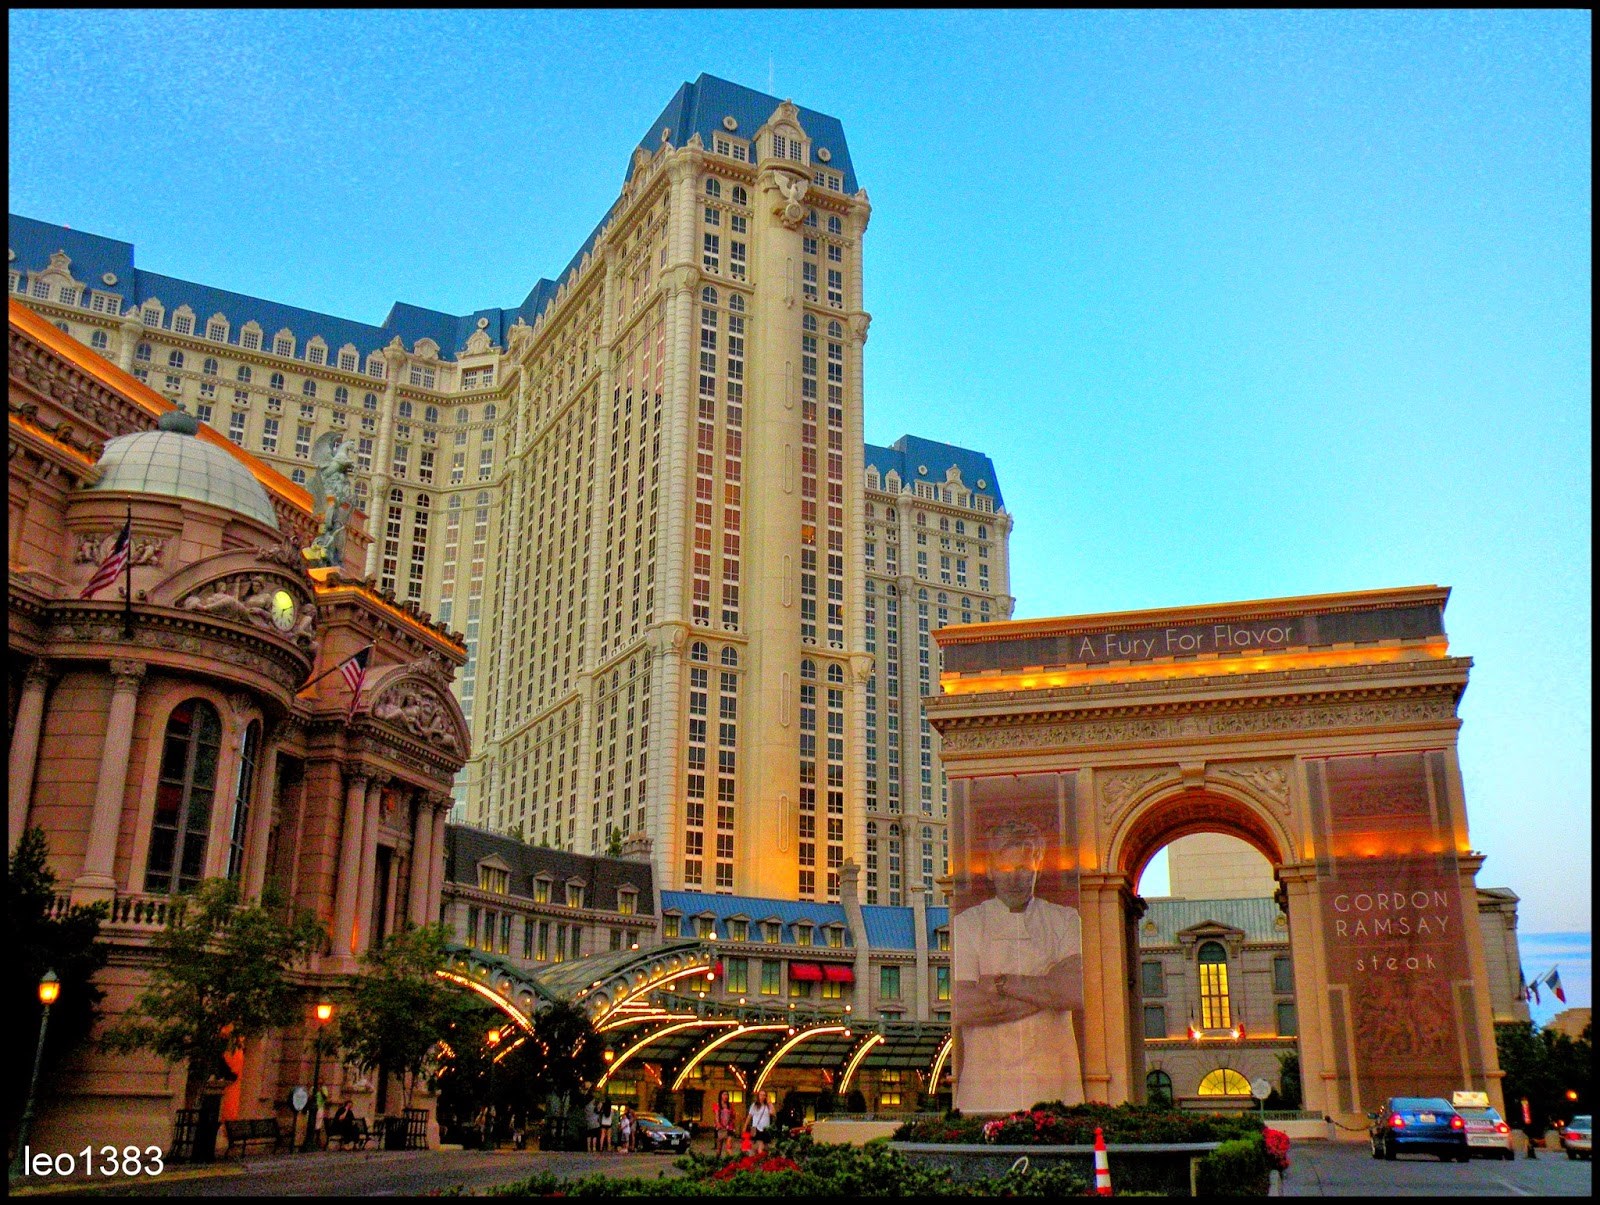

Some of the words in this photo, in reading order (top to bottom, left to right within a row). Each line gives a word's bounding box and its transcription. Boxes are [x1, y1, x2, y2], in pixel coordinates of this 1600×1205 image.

[1078, 636, 1096, 659] A
[1105, 634, 1155, 657] Fury
[1165, 629, 1204, 651] For
[1214, 624, 1292, 647] Flavor
[1334, 891, 1448, 912] GORDON
[1336, 916, 1449, 937] RAMSAY
[1356, 954, 1436, 972] steak
